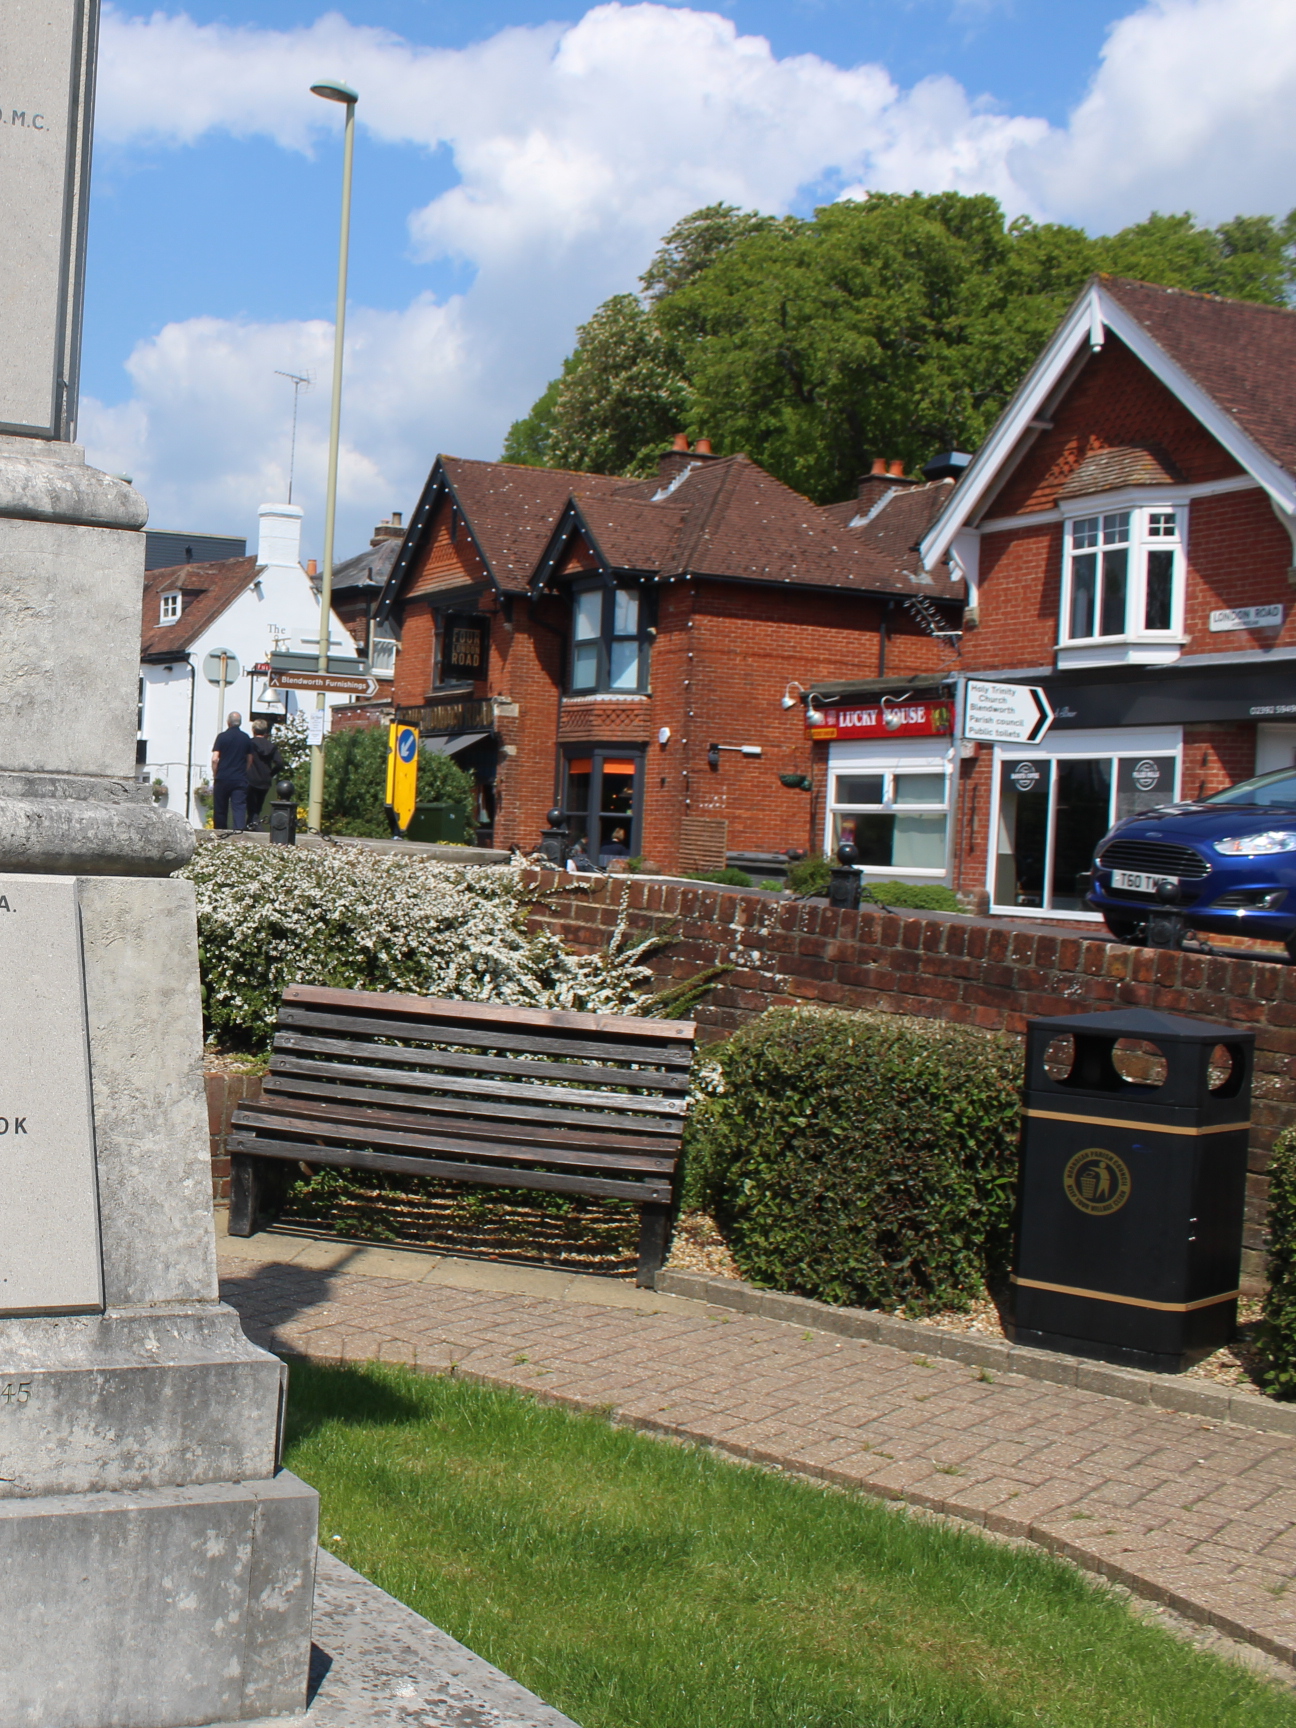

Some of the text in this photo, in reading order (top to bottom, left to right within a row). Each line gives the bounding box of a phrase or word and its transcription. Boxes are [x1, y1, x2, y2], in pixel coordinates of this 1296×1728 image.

[1213, 606, 1279, 623] LONDON ROAD
[267, 624, 286, 635] The
[453, 630, 480, 644] FOUR
[451, 653, 479, 666] ROAD
[281, 677, 366, 690] Blendworth Furnishings
[970, 685, 1016, 697] Holy Trinity
[978, 695, 1007, 704] Church
[970, 703, 1015, 714] Blendworth
[839, 709, 878, 728] LUCKY
[969, 715, 1024, 727] Parish council
[968, 727, 1020, 738] Public toilets
[1120, 873, 1142, 888] T60
